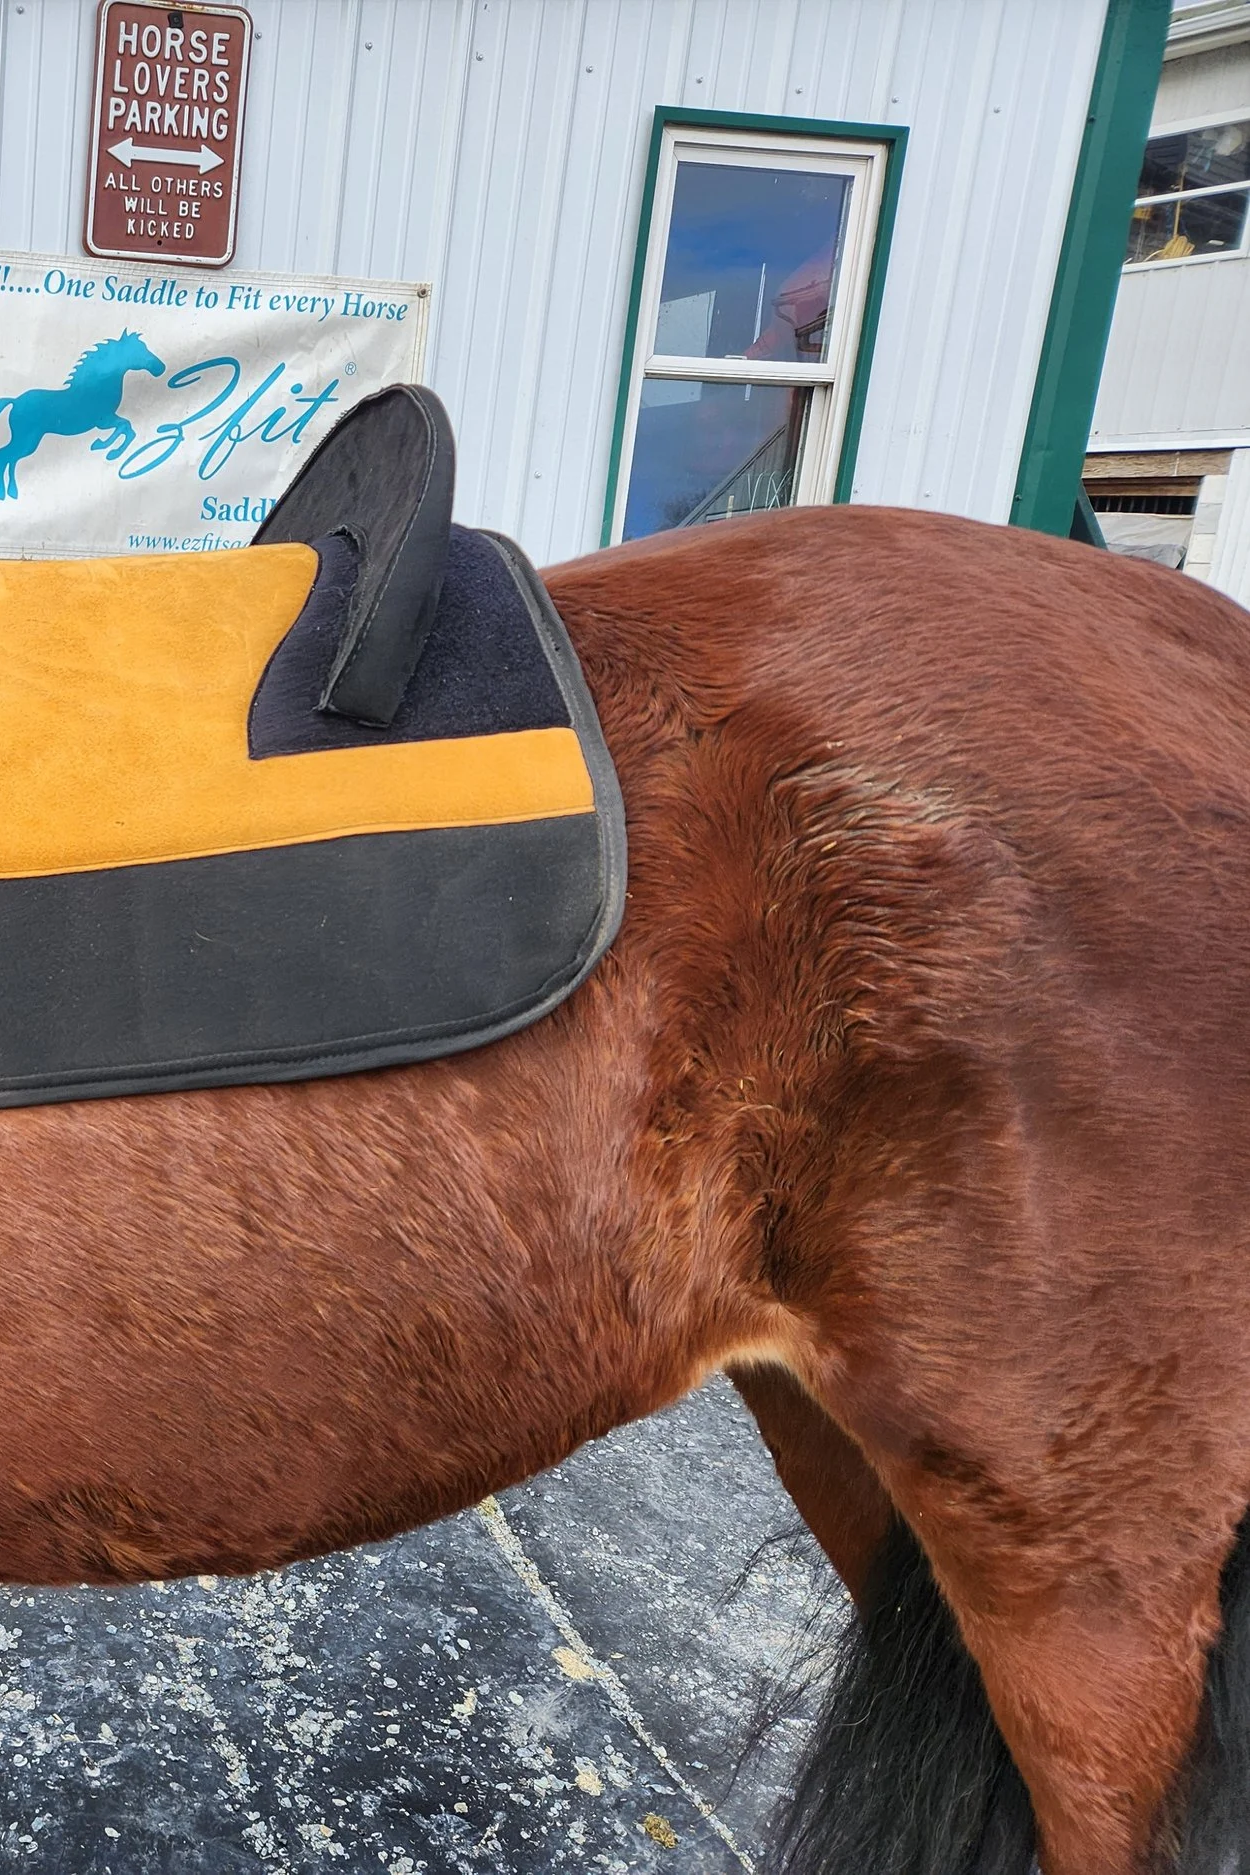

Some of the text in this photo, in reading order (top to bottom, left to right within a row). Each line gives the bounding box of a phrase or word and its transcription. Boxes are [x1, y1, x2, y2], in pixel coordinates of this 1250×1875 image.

[117, 21, 230, 66] HORSE
[113, 59, 230, 104] LOVERS
[107, 97, 229, 141] PARKING
[104, 172, 223, 199] ALL OTHERS
[124, 196, 201, 218] WILL BE
[127, 218, 195, 240] KICKED
[101, 275, 188, 307] Saddle
[195, 284, 219, 309] to
[225, 285, 264, 310] Fit
[269, 294, 335, 322] every
[340, 292, 409, 321] Horse
